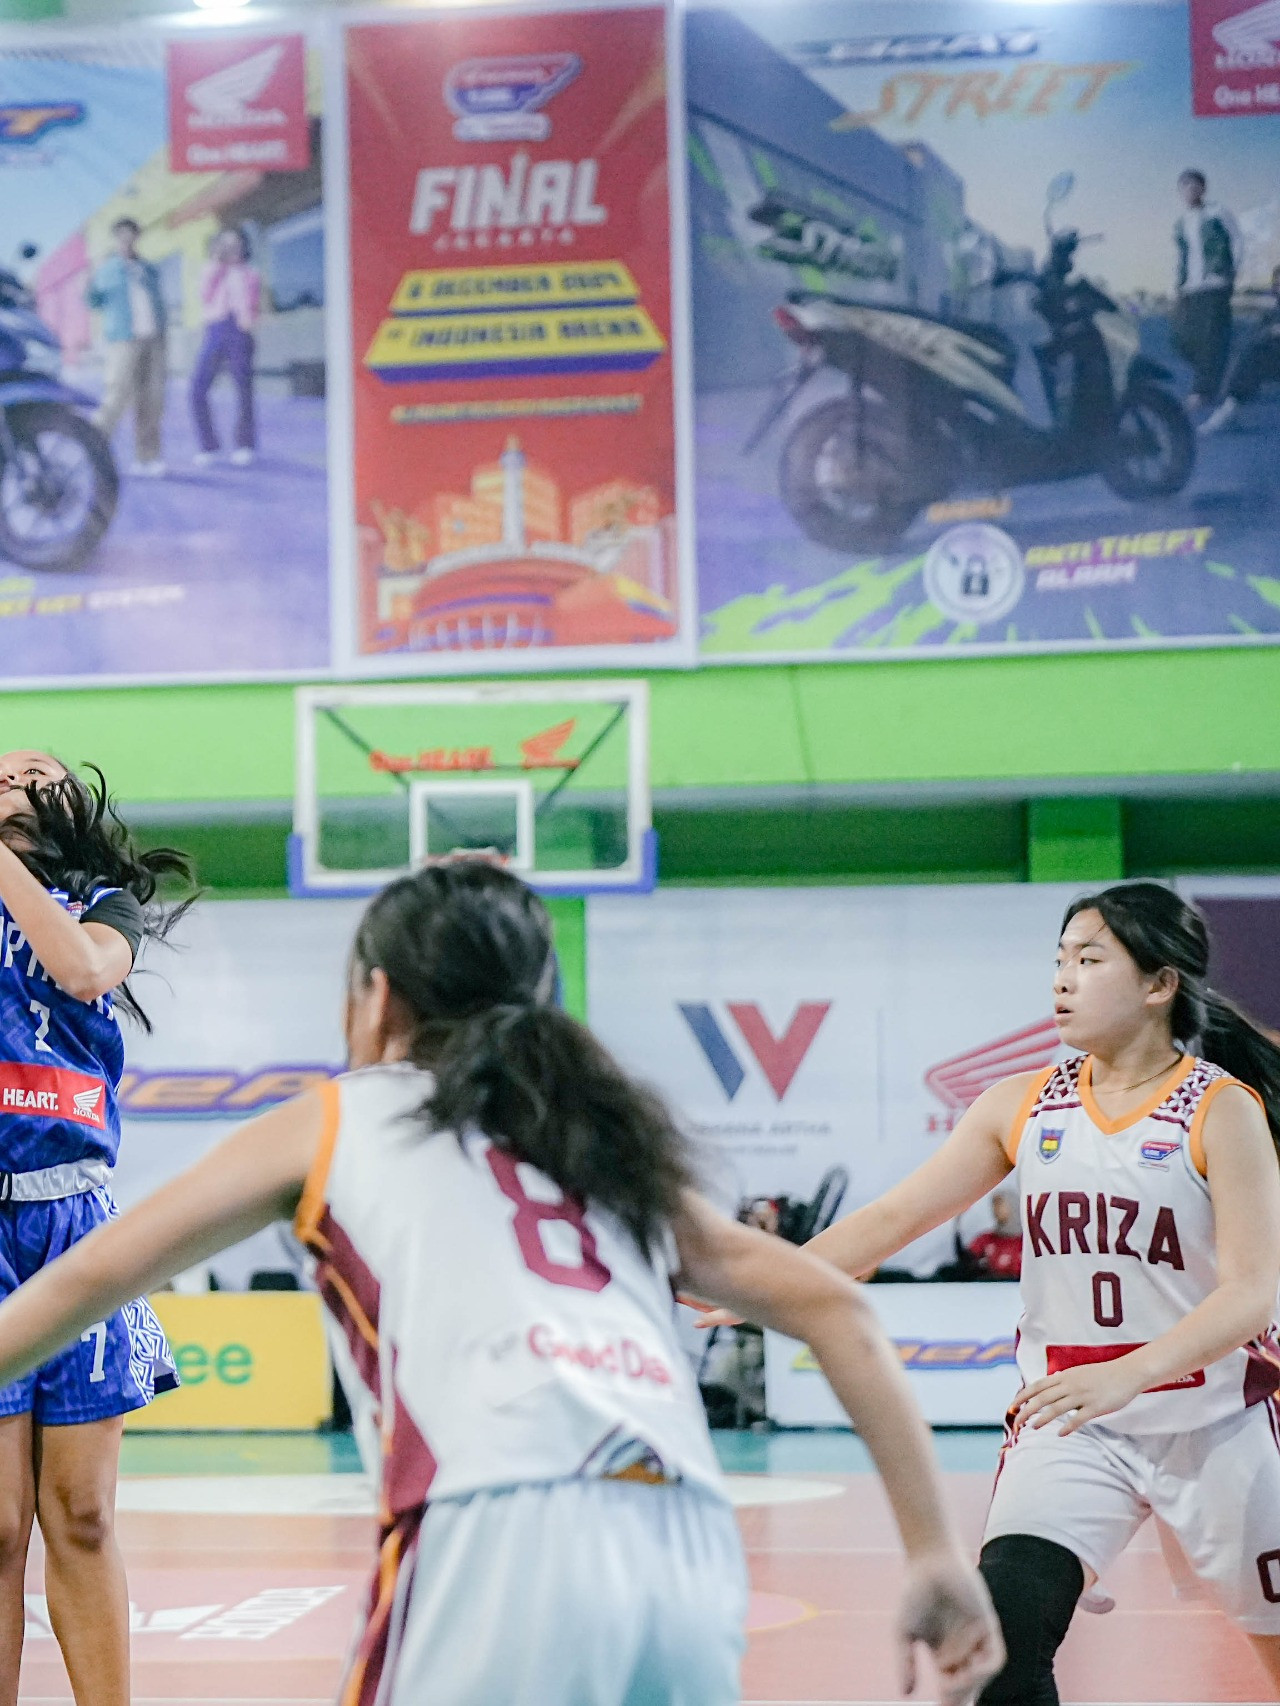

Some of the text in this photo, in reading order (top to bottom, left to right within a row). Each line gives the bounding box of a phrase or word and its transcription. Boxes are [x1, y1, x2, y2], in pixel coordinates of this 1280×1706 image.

[828, 60, 1138, 131] STREET
[410, 152, 607, 235] FINAL
[1100, 527, 1213, 559] THEFT
[73, 1107, 100, 1124] HONDA
[484, 1145, 612, 1293] 8
[1026, 1191, 1186, 1271] KRIZA
[1092, 1271, 1124, 1328] 0
[80, 1320, 108, 1383] 7
